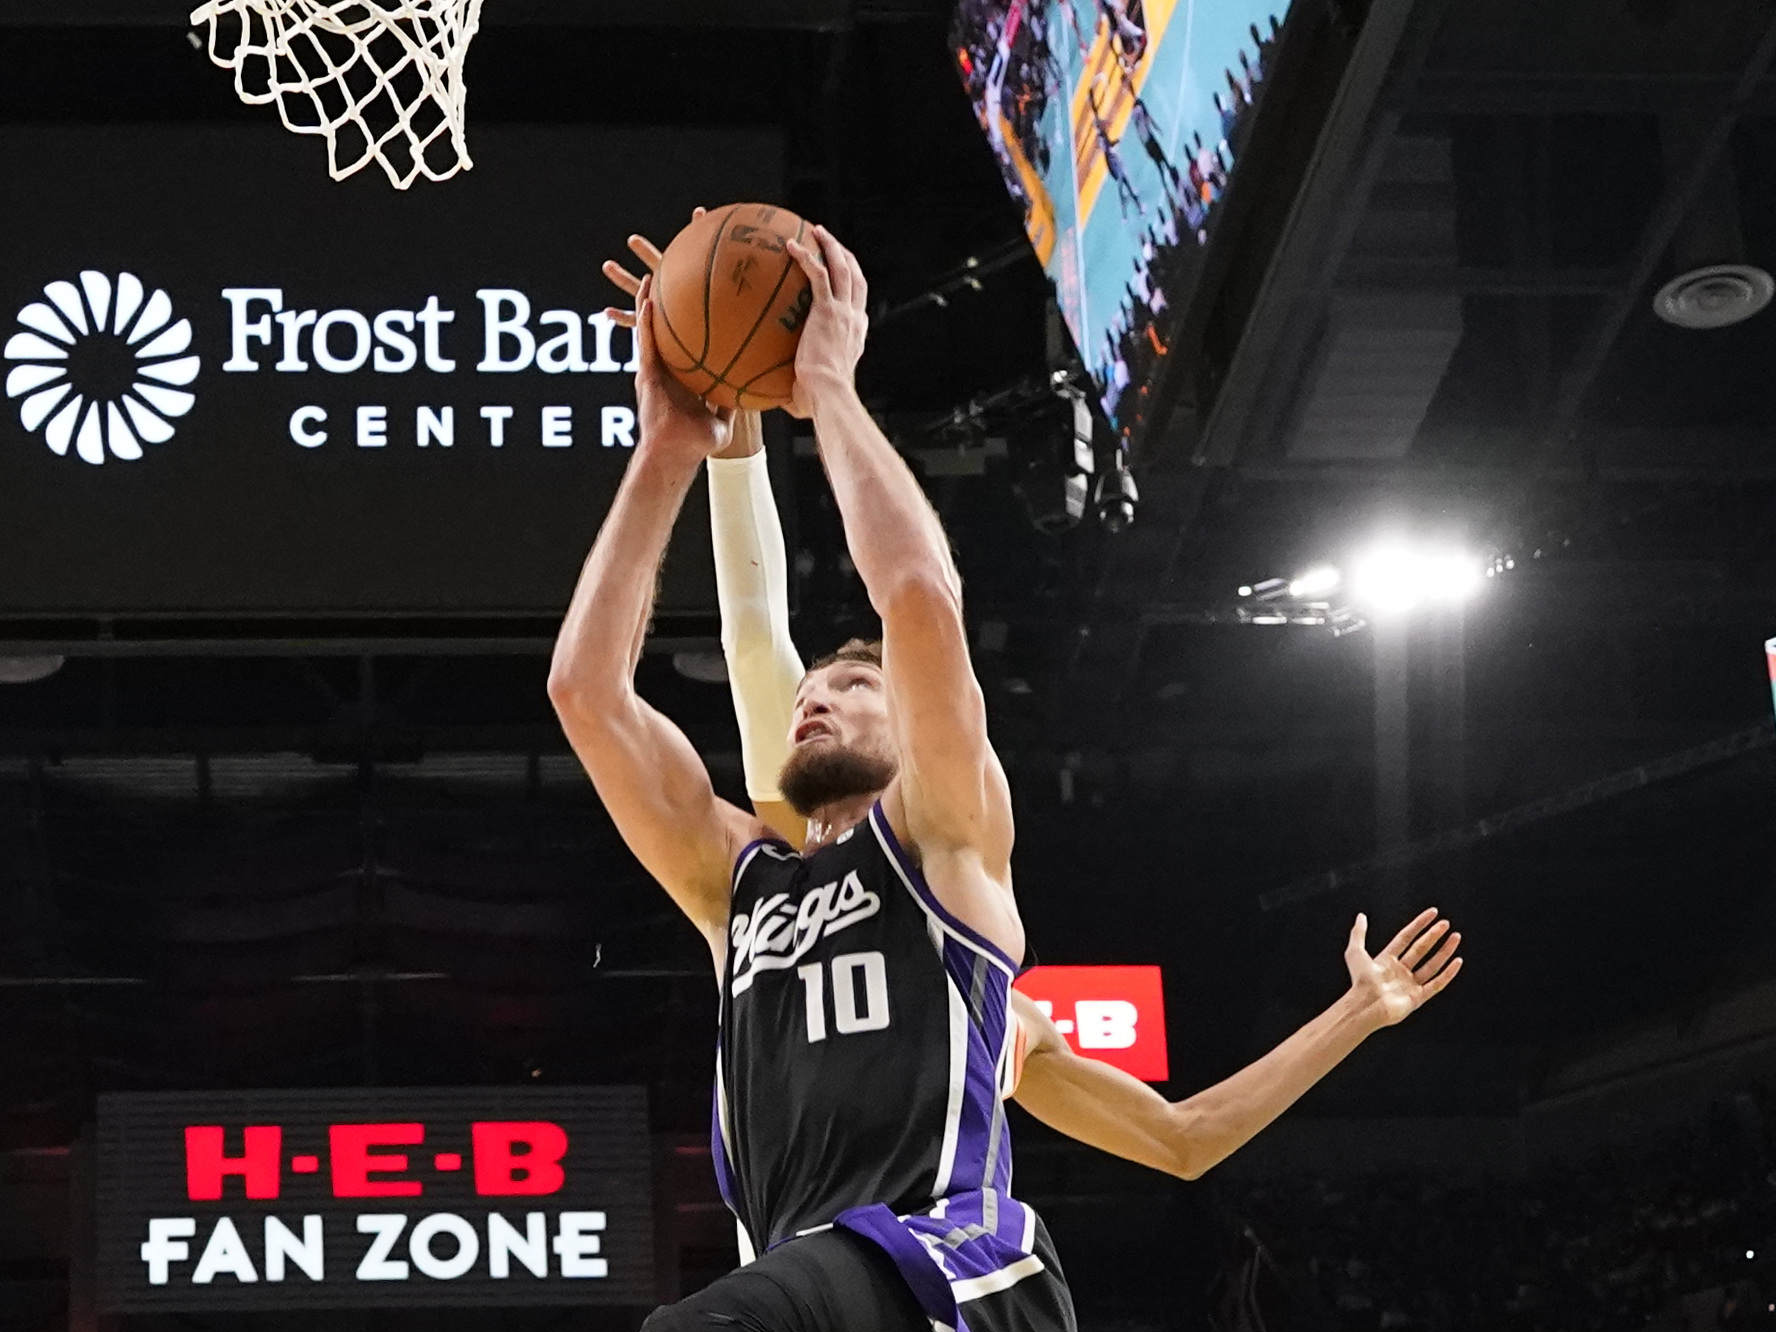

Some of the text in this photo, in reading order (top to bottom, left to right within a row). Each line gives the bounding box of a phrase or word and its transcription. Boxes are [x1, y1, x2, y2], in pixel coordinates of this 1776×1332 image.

[222, 288, 639, 374] Frost Ban
[289, 406, 635, 448] CENTER
[797, 951, 890, 1043] 10
[185, 1121, 569, 1200] H-E-B
[141, 1211, 609, 1285] FAN ZONE
